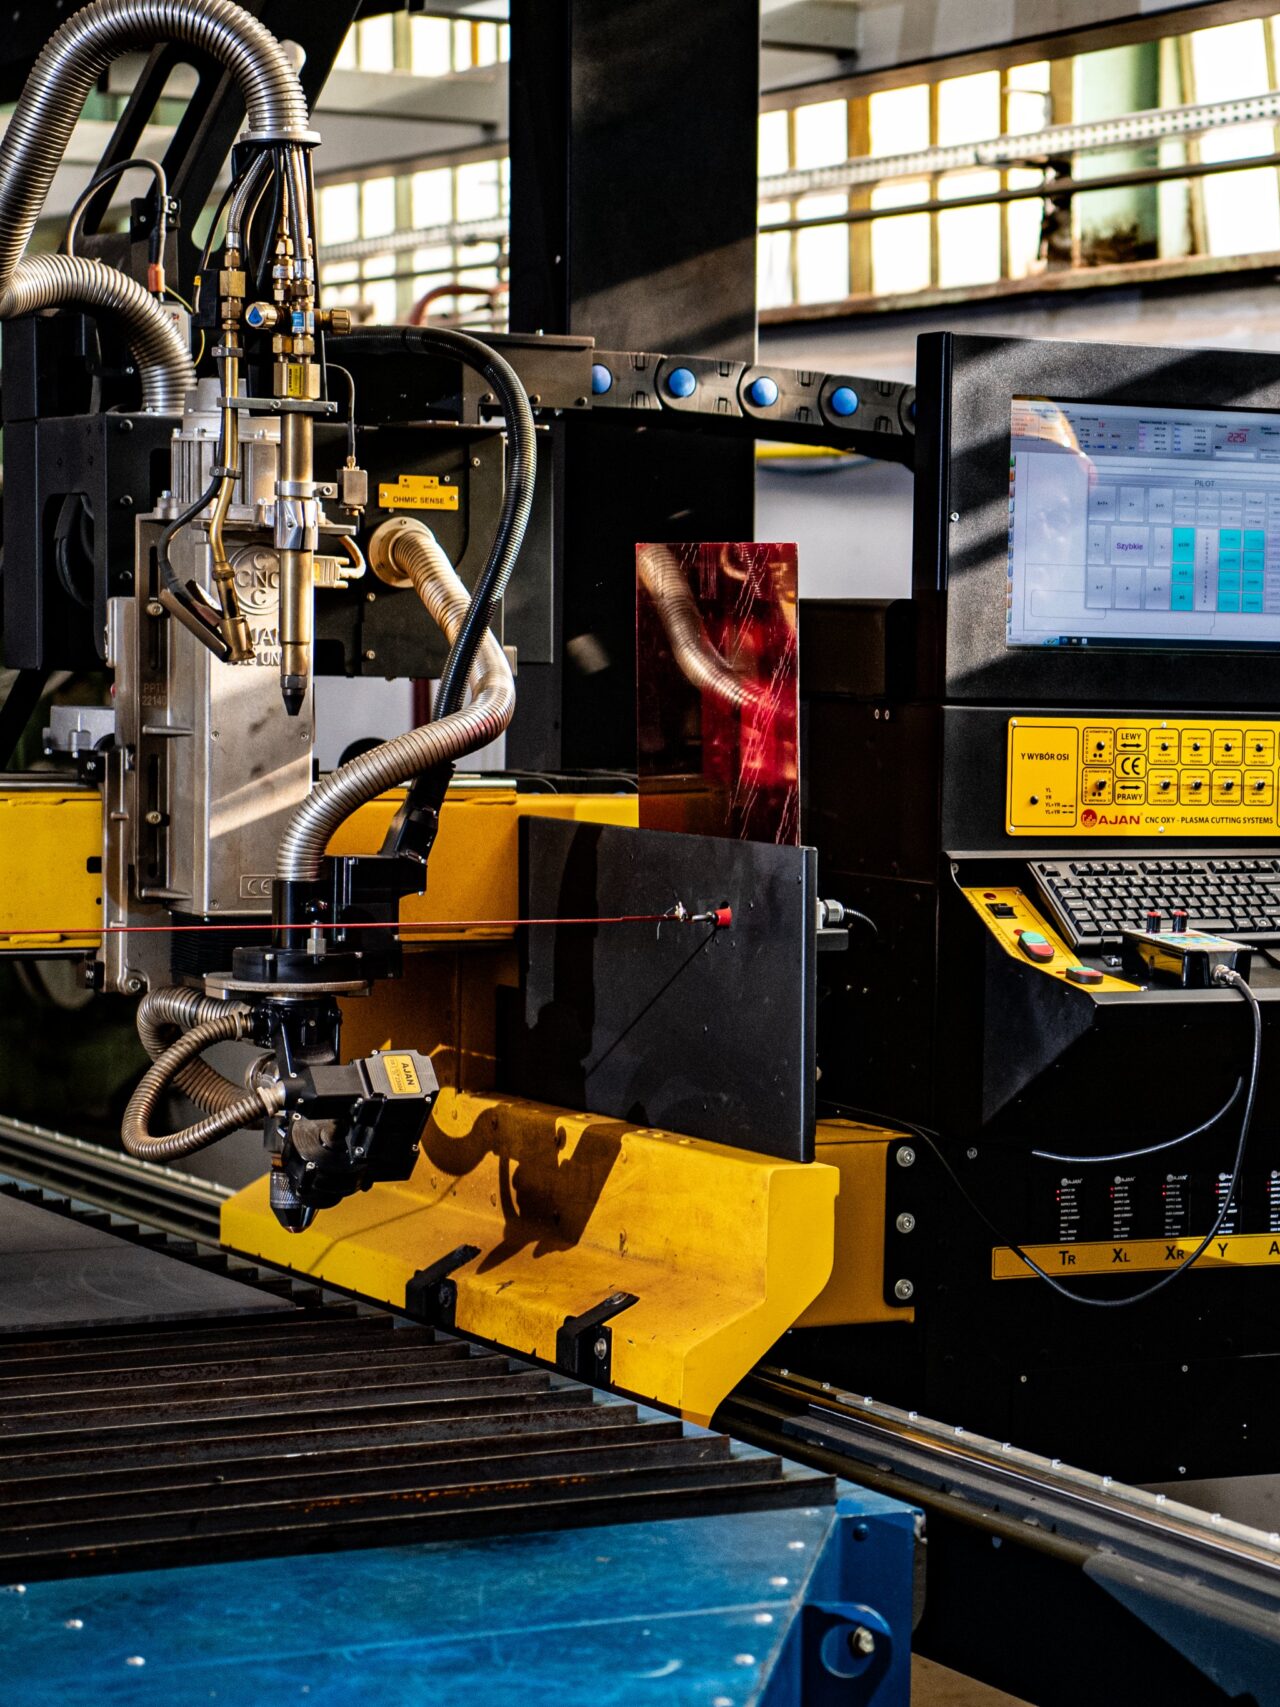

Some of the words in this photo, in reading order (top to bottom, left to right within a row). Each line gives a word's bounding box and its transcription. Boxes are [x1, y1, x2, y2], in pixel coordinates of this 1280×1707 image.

[1194, 479, 1216, 488] PILOT
[393, 496, 418, 504] OHMIC
[420, 497, 445, 505] SENSE
[1116, 542, 1144, 552] Szybkie
[1027, 752, 1055, 760] WYBÓR
[1121, 757, 1141, 775] CE
[1117, 793, 1143, 801] PRAWY
[1098, 815, 1140, 825] AJAN
[1145, 816, 1160, 824] CNC
[401, 1062, 416, 1086] AJAN
[1217, 1243, 1228, 1257] Y
[1269, 1241, 1280, 1255] A
